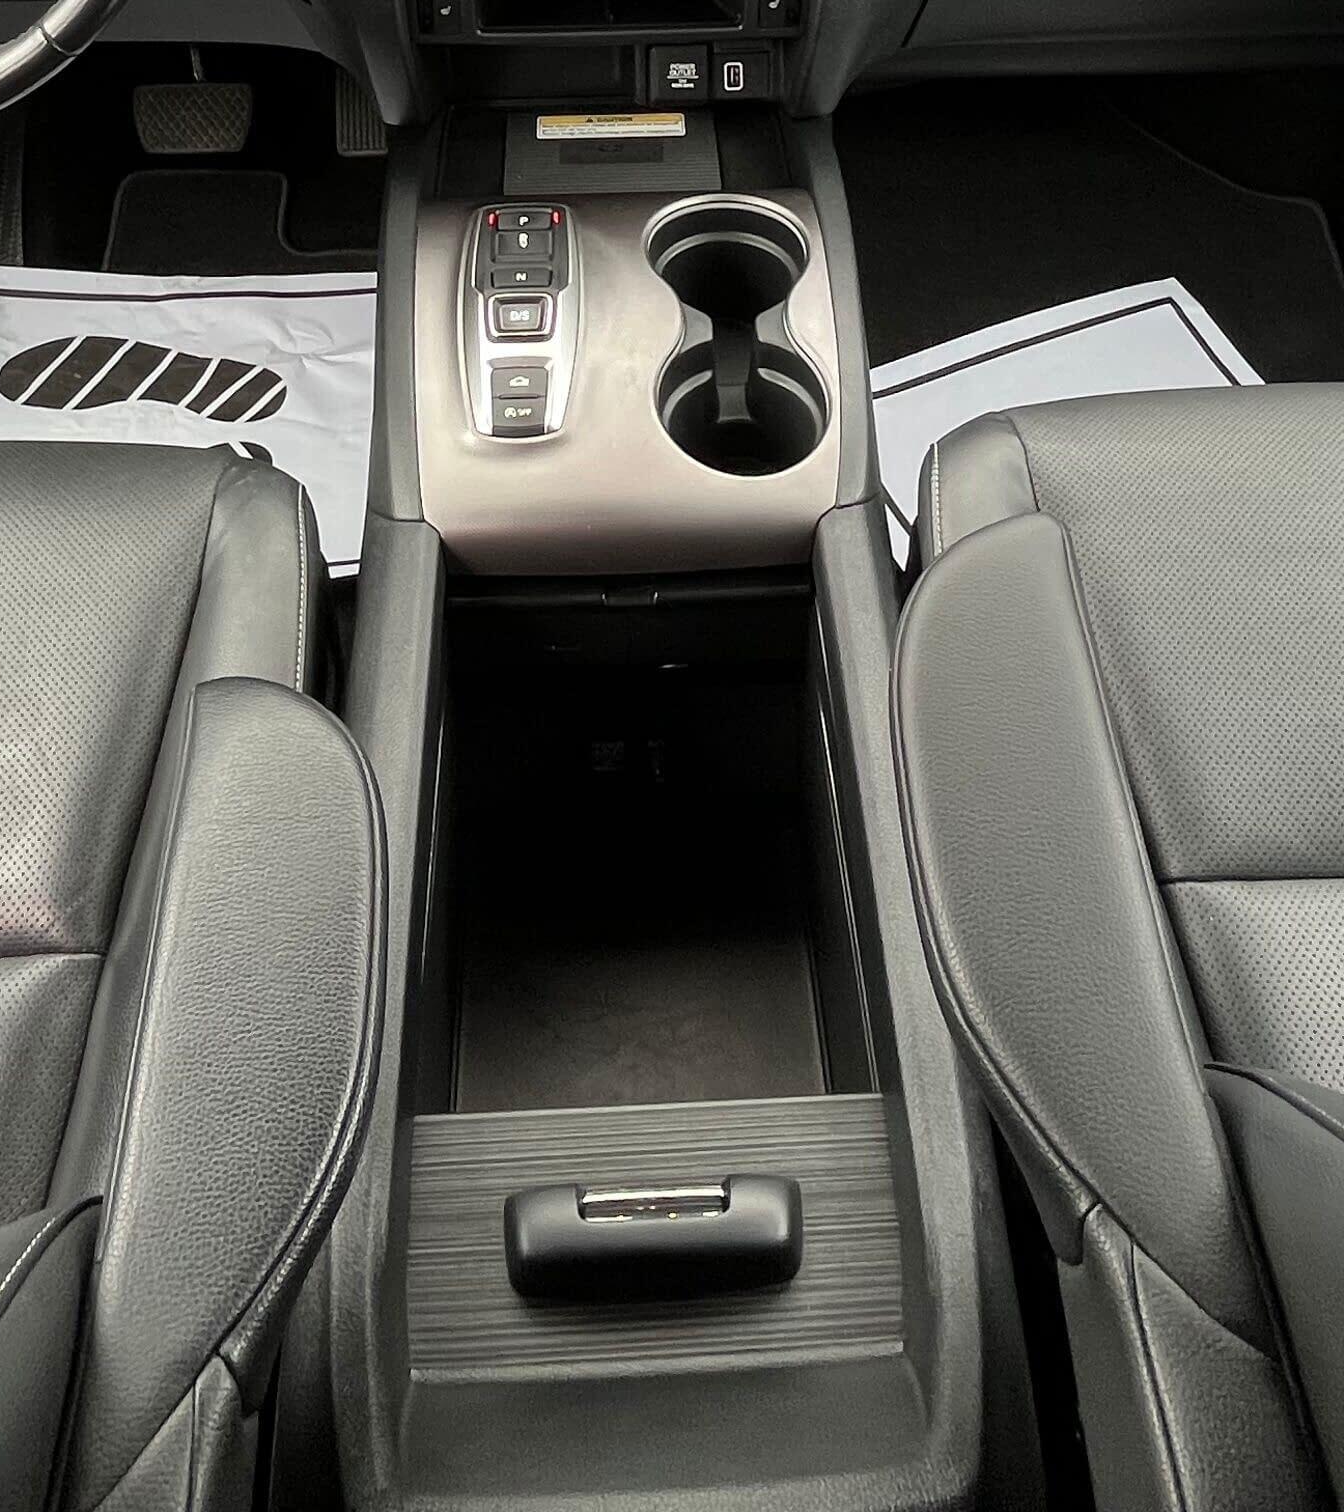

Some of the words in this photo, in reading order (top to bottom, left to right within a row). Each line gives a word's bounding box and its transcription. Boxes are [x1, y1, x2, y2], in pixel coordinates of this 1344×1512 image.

[519, 216, 529, 226] P
[516, 272, 527, 282] N
[510, 309, 531, 323] D/S
